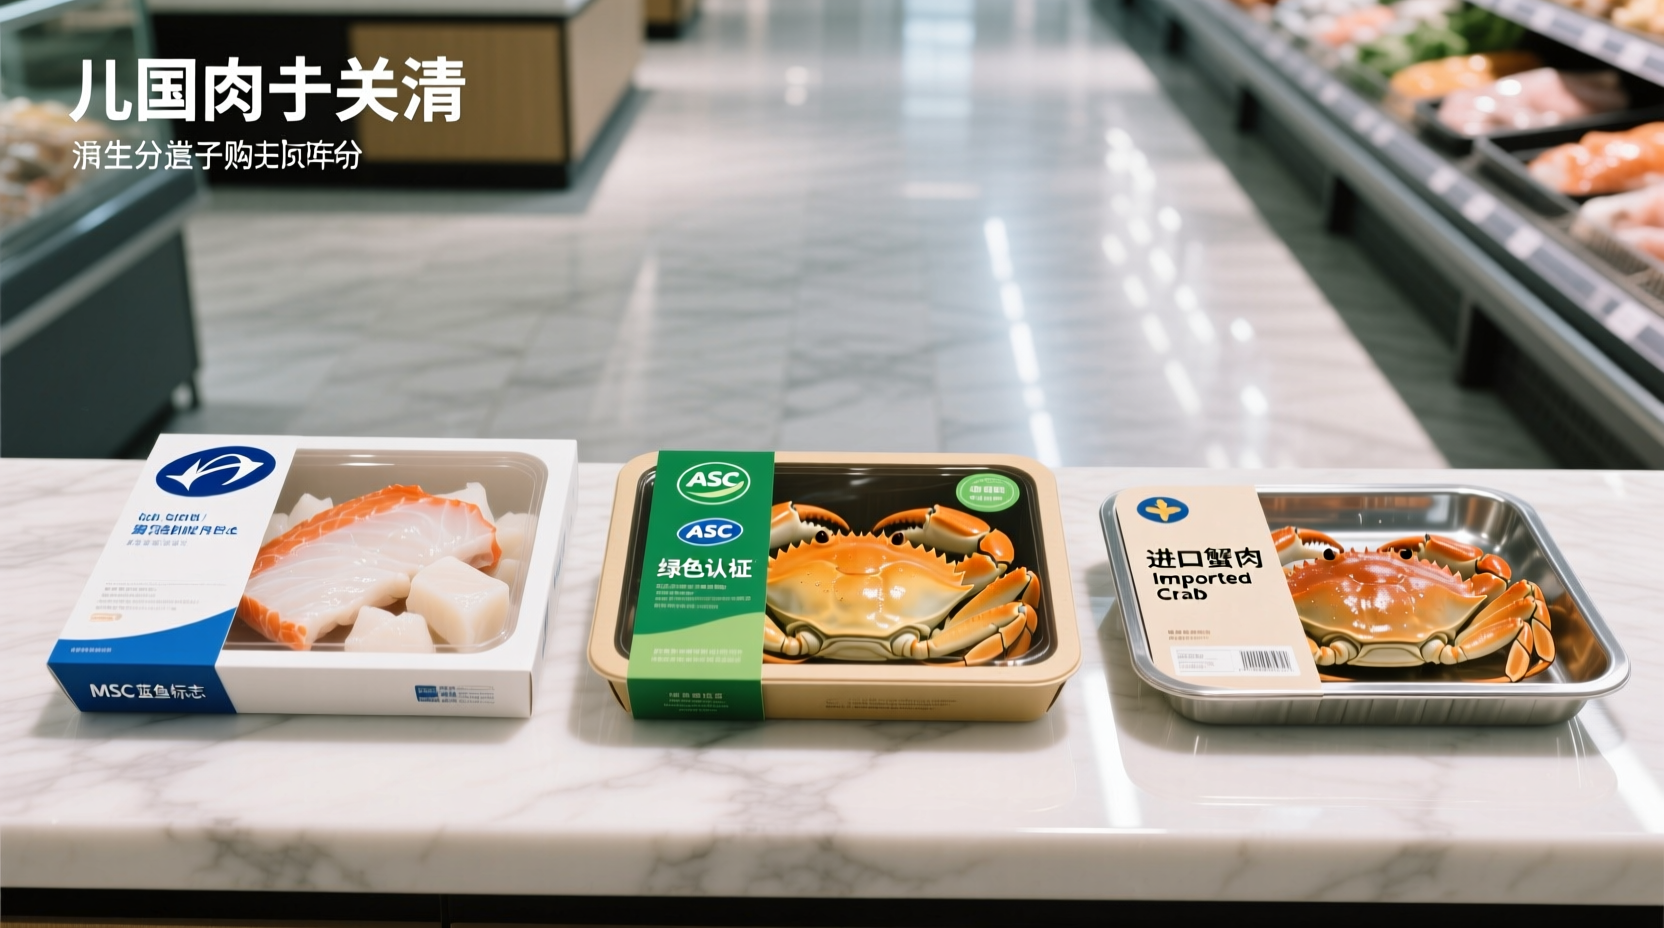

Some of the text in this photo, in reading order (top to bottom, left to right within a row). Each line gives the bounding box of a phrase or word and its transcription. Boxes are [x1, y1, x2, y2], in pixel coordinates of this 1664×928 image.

[685, 471, 740, 487] ASC
[685, 524, 733, 539] ASC
[1146, 547, 1263, 568] 进口蟹肉
[1153, 572, 1252, 589] Imported
[1157, 588, 1208, 600] Crab
[89, 683, 135, 698] MSC
